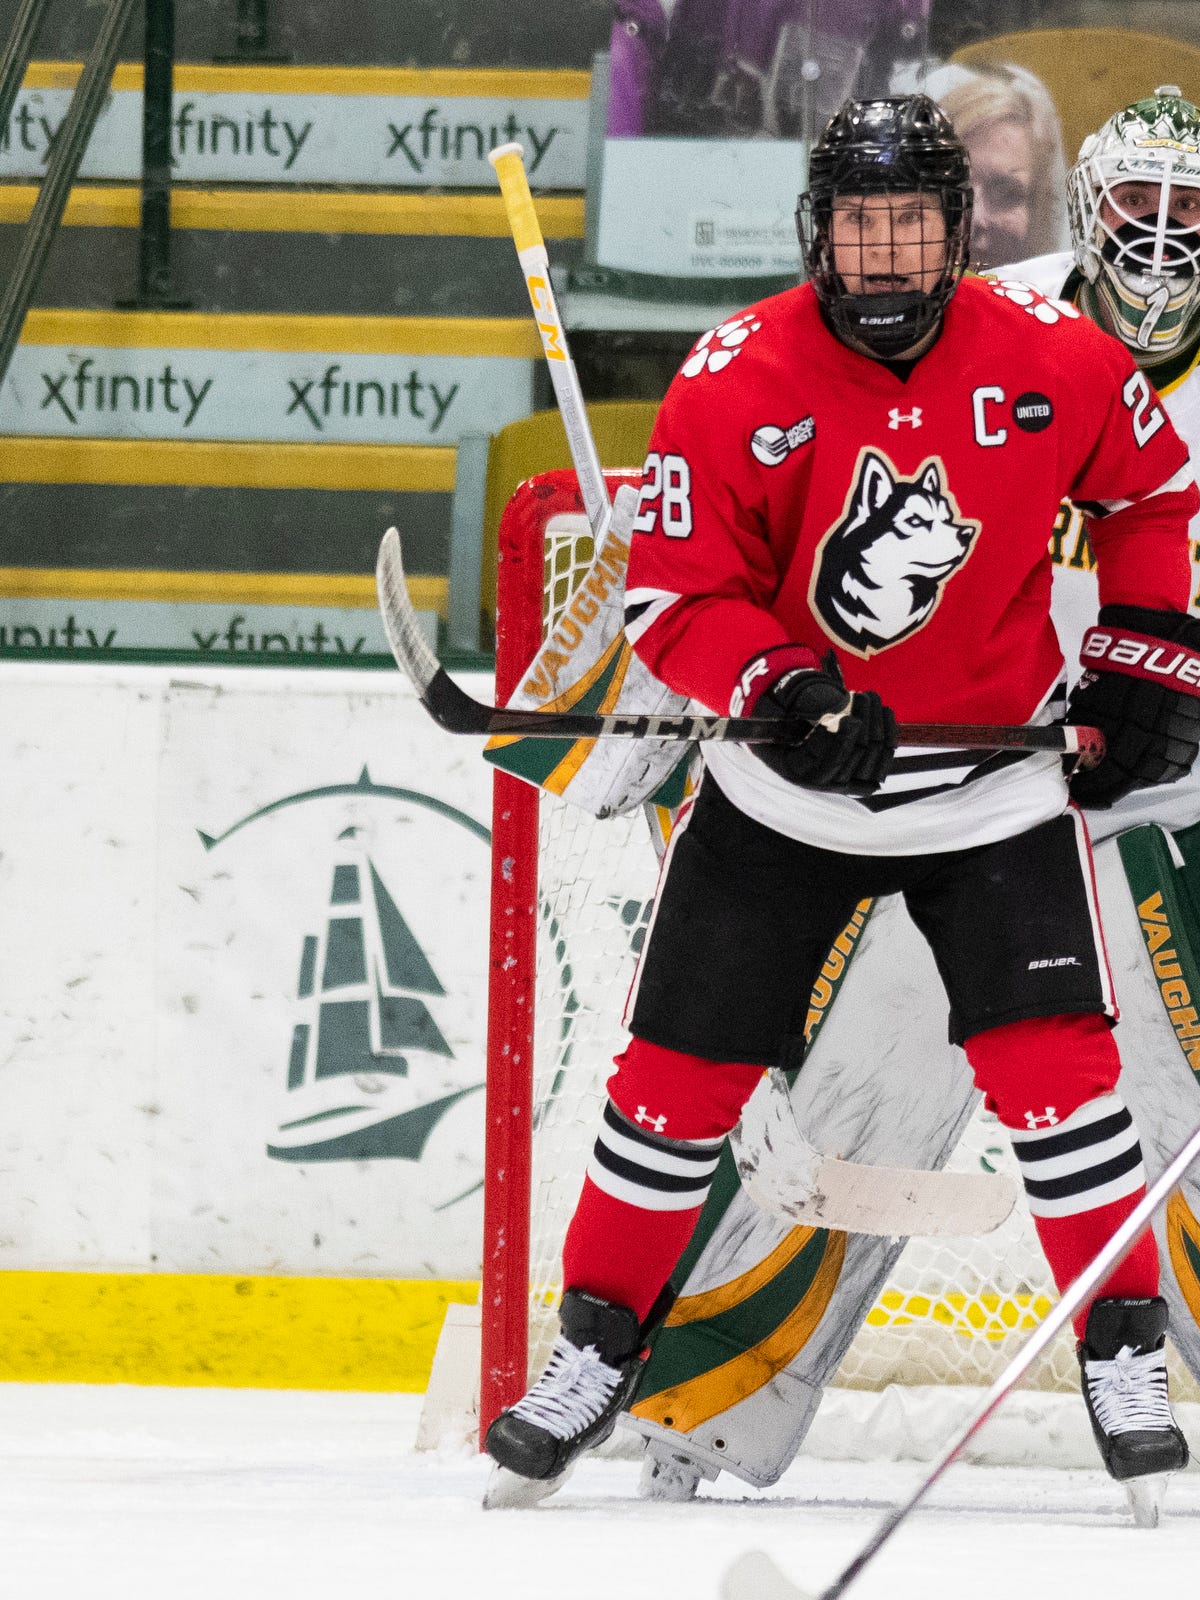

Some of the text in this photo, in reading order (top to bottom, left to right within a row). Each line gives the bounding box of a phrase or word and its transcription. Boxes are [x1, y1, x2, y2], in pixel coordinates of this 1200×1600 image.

[172, 103, 312, 169] finity
[386, 107, 559, 173] xfinity
[41, 359, 214, 427] xfinity
[286, 365, 460, 432] xfinity
[972, 386, 1007, 447] C
[1016, 405, 1049, 418] UNITED
[632, 451, 693, 538] 28
[522, 530, 631, 699] VAUGHN
[598, 715, 731, 741] CCM
[1028, 957, 1082, 970] BAUER
